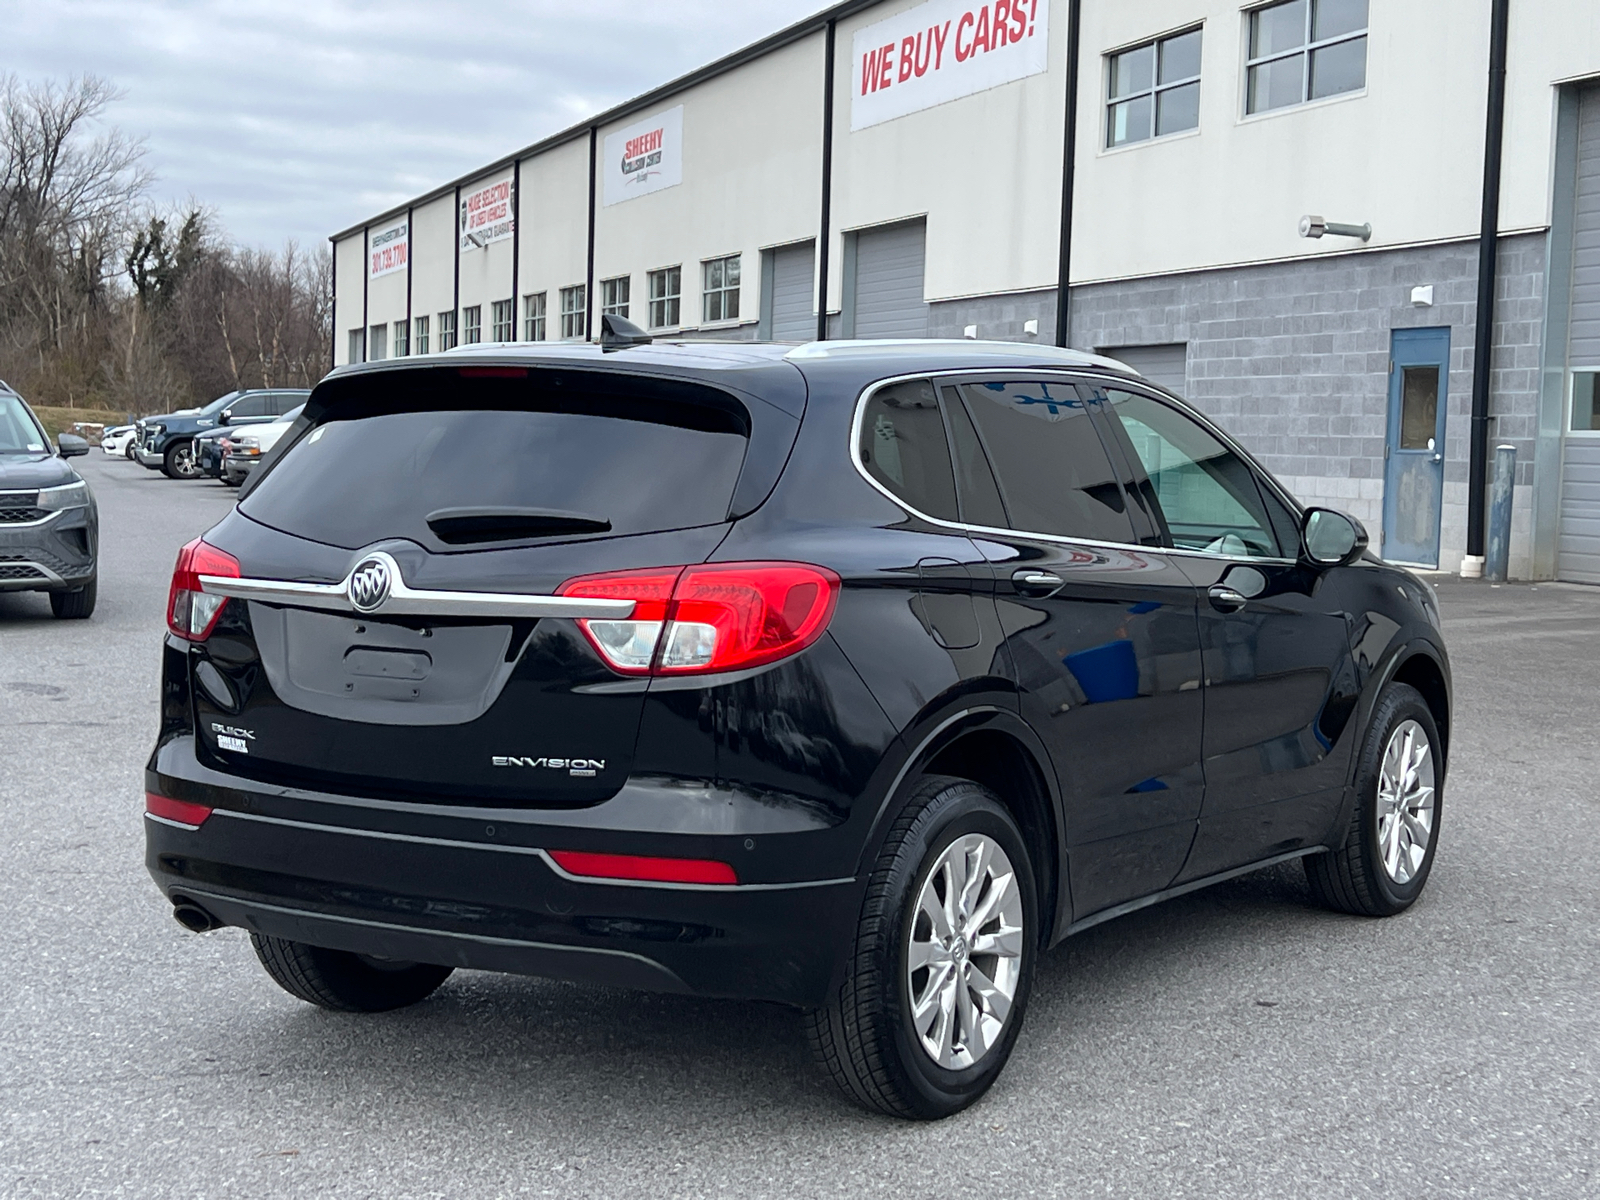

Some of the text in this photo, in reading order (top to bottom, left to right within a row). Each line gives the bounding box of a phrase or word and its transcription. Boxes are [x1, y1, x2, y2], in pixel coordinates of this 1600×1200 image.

[861, 0, 1038, 96] WE BUY CARS!
[625, 127, 664, 160] SHEEHY
[468, 181, 510, 213] HUGE SELECTION
[469, 214, 475, 229] OF
[487, 202, 507, 222] VEHICLES
[372, 242, 407, 274] 301.739.7700
[211, 722, 256, 740] BUICK
[492, 755, 606, 769] ENVISION
